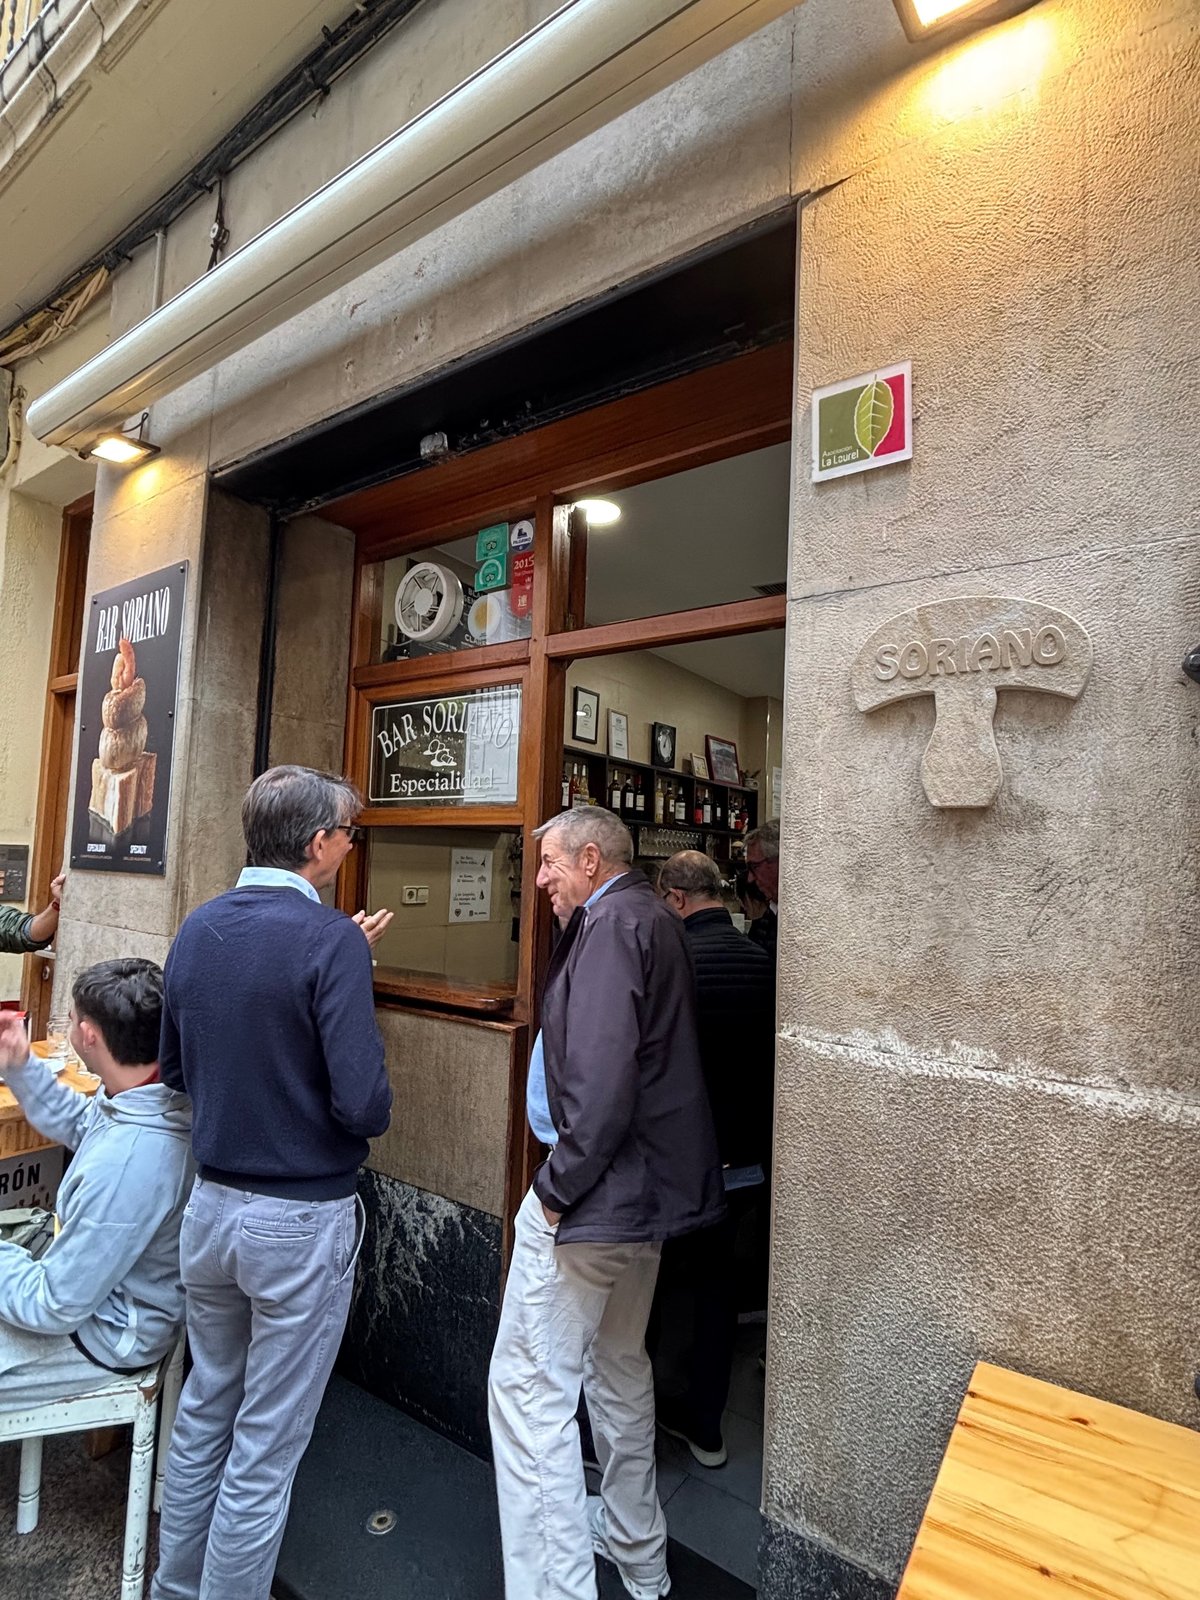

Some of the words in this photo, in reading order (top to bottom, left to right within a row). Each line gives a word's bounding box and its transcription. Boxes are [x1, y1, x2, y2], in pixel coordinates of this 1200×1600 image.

[822, 457, 832, 467] La
[833, 449, 859, 464] Laurel
[513, 554, 534, 570] 2015
[95, 606, 119, 653] BAR
[120, 586, 171, 642] SORIANO
[874, 623, 1067, 682] SORIANO
[376, 712, 418, 759] BAR
[422, 701, 514, 749] SORIANO
[389, 767, 495, 797] Especialidad
